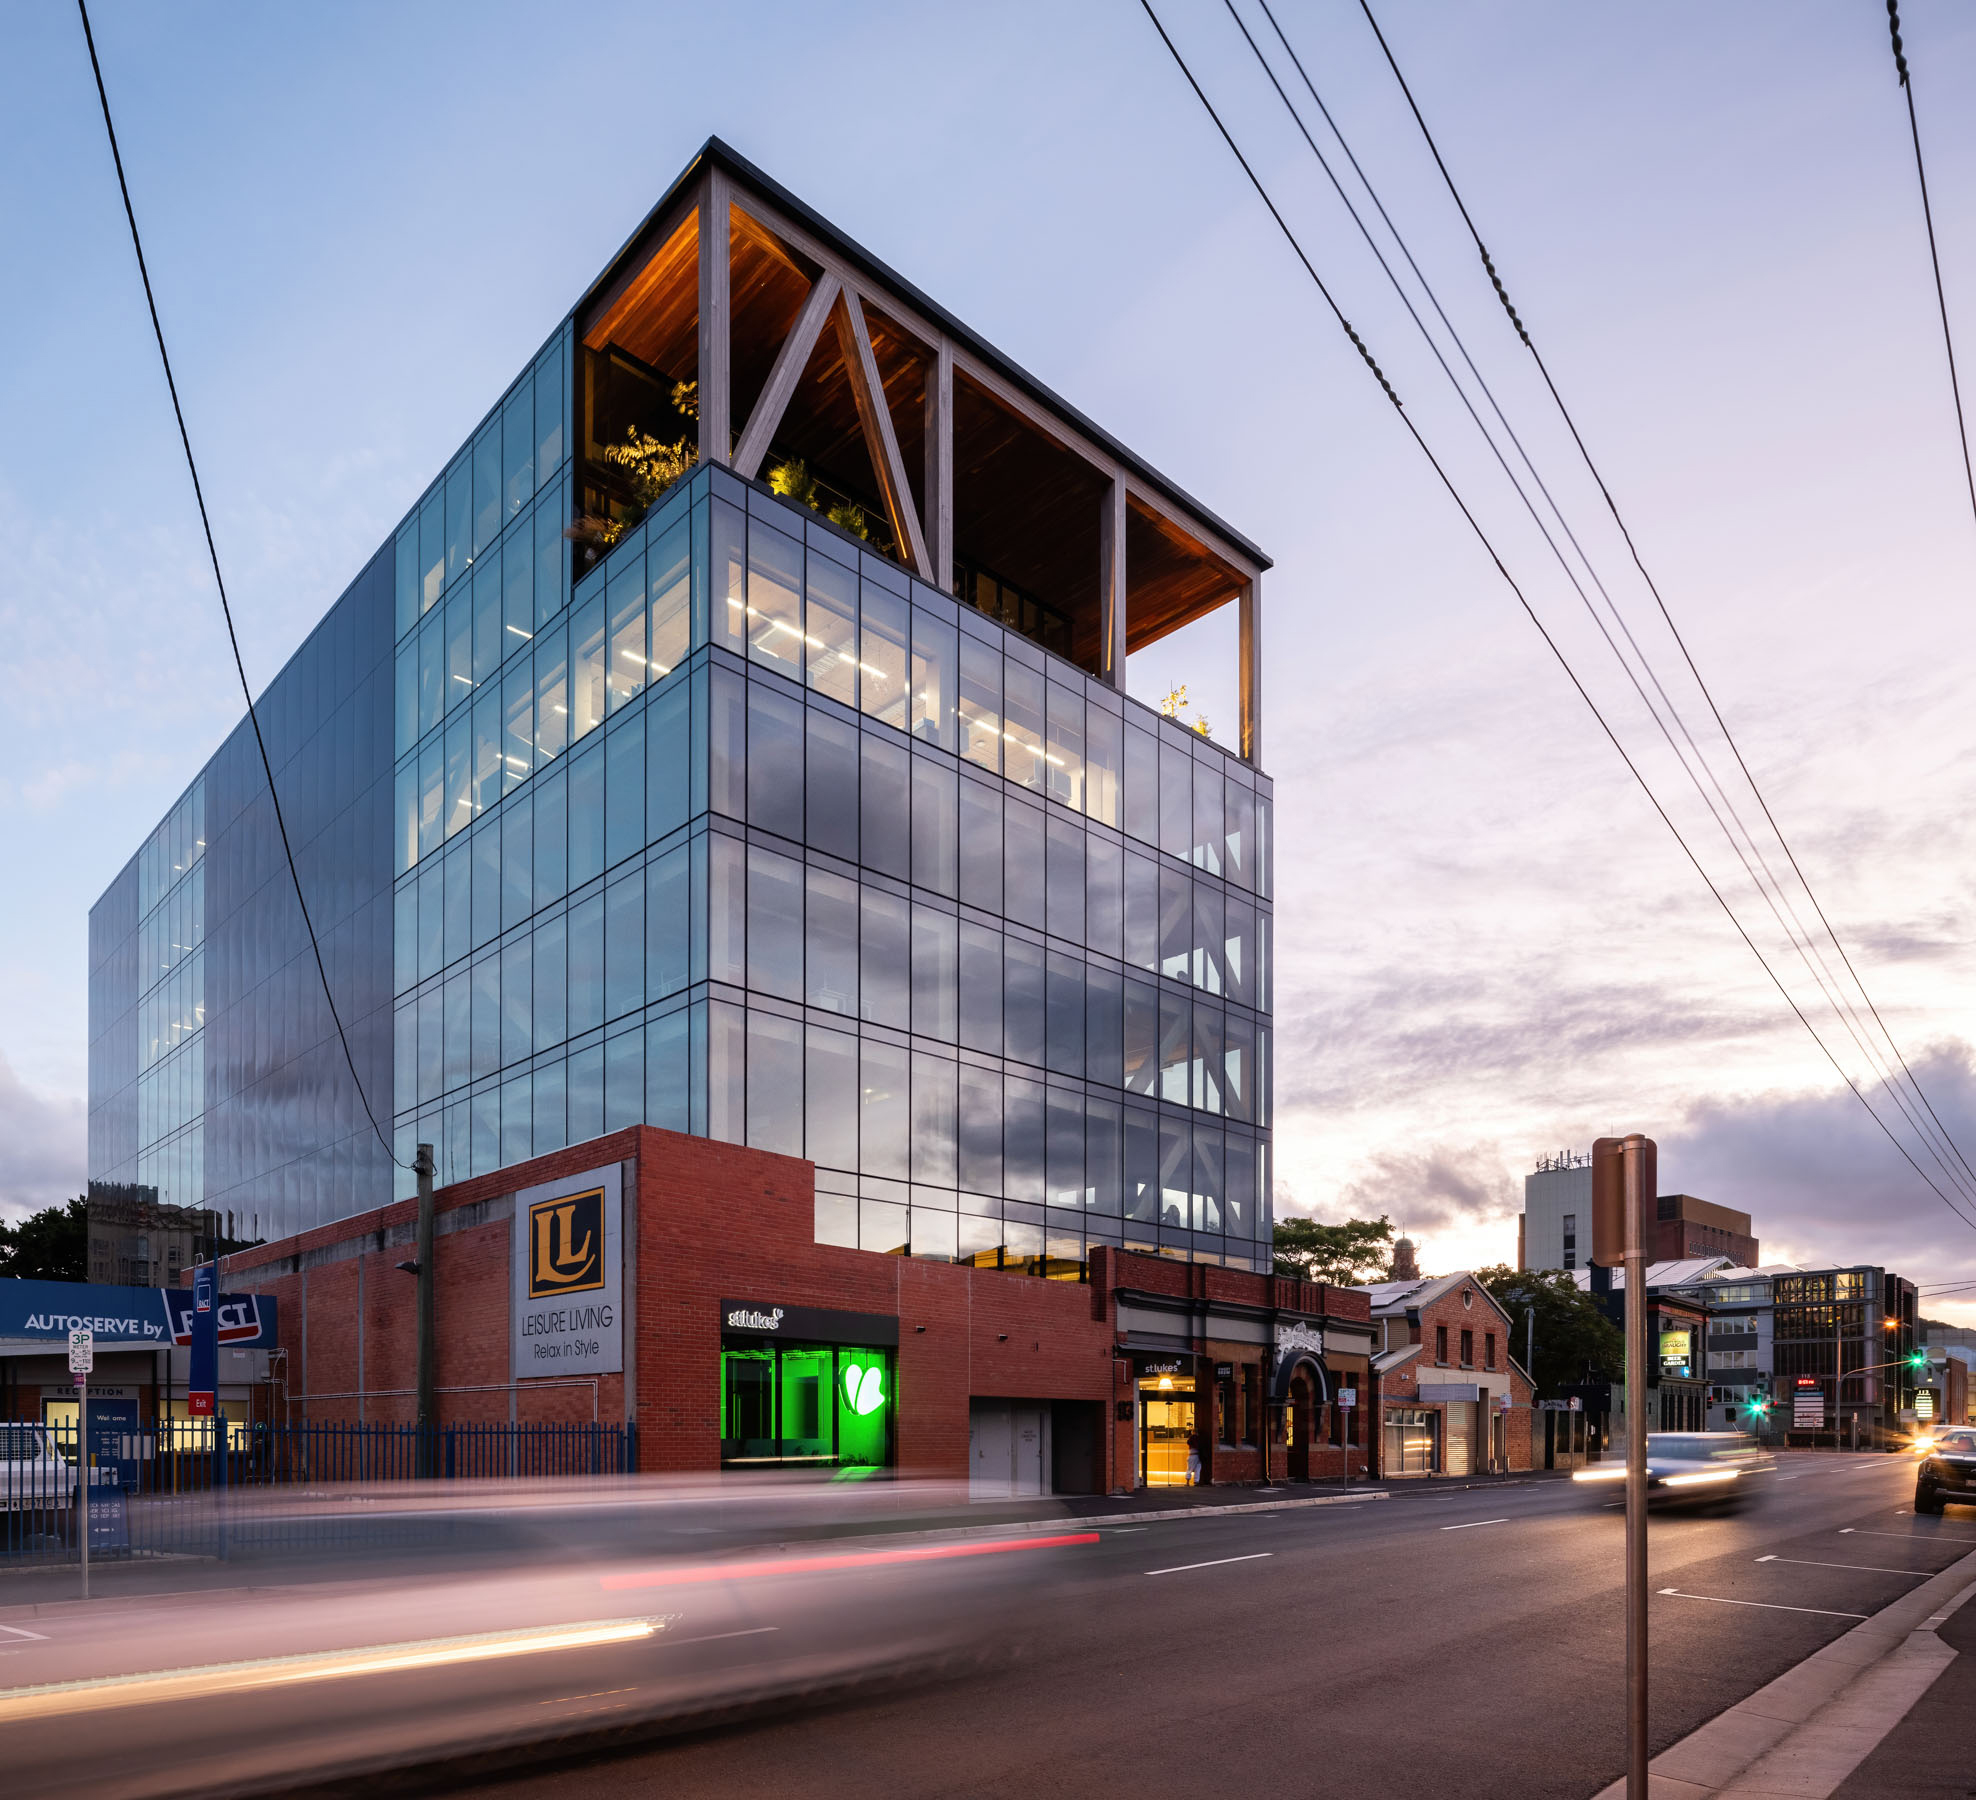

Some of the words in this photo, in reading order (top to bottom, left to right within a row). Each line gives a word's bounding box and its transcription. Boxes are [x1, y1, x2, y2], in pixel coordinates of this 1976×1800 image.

[24, 1313, 139, 1334] AUTOSERVE
[143, 1319, 164, 1339] by
[180, 1303, 248, 1333] RCT
[522, 1310, 566, 1337] LEISURE
[569, 1305, 613, 1331] LIVING
[72, 1334, 90, 1344] 3P
[534, 1342, 561, 1359] Relax
[563, 1341, 573, 1356] in
[574, 1338, 600, 1359] Style
[57, 1387, 123, 1396] RECPTION
[195, 1398, 207, 1408] Exit
